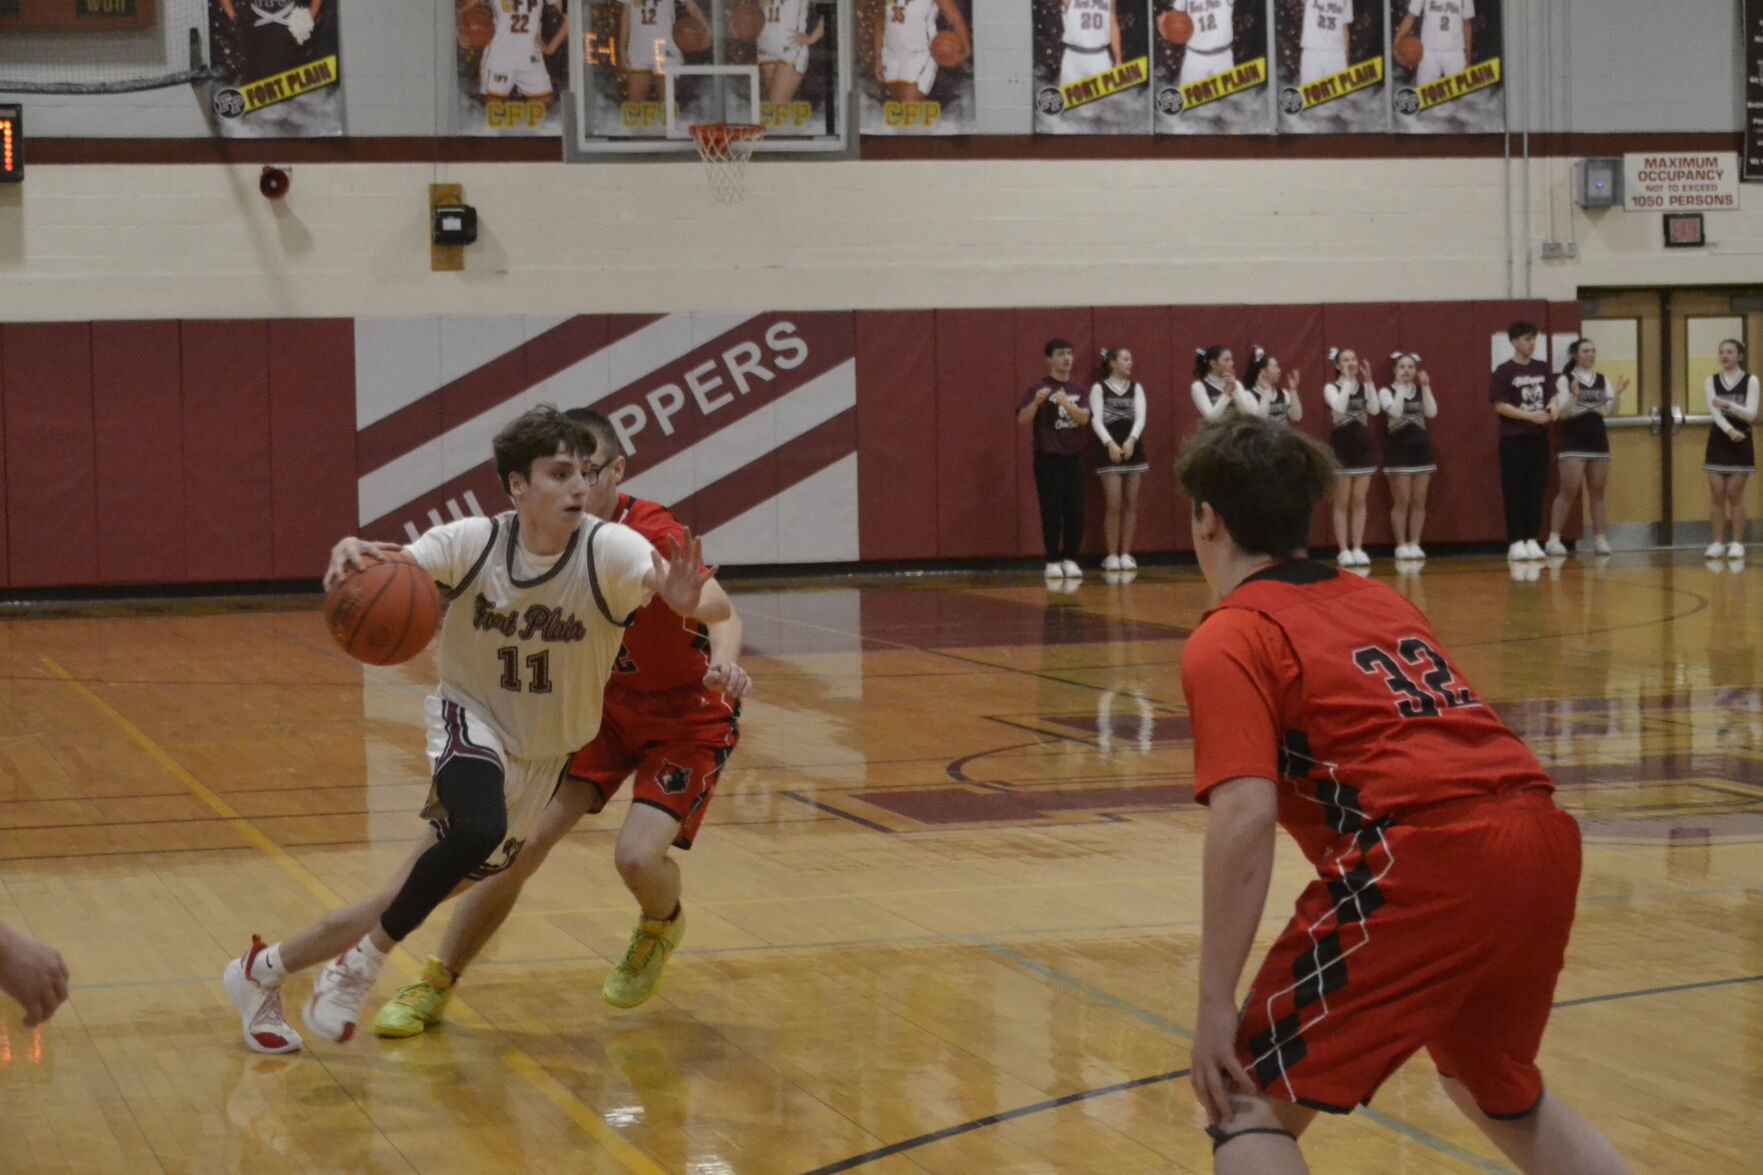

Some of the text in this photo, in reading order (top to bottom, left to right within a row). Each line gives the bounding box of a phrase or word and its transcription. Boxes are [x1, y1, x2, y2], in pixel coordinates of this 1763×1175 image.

[510, 14, 529, 33] 22
[1081, 13, 1103, 30] 20
[1439, 16, 1450, 31] 2
[245, 62, 331, 107] FORT PLAIN
[1065, 63, 1142, 106] FORT PLAIN
[1184, 63, 1260, 105] FORT PLAIN
[1303, 78, 1337, 105] FORT
[1339, 62, 1378, 91] PLAIN
[1421, 63, 1495, 106] FORT PLAIN
[1638, 170, 1724, 182] OCCUPANCY
[1644, 157, 1719, 169] MAXIMUM
[1633, 195, 1733, 207] 1050 PERSONS
[1645, 184, 1718, 192] NOT TO EXCEED
[473, 592, 587, 643] Fort Plain
[497, 646, 553, 694] 11
[1352, 636, 1484, 719] 32
